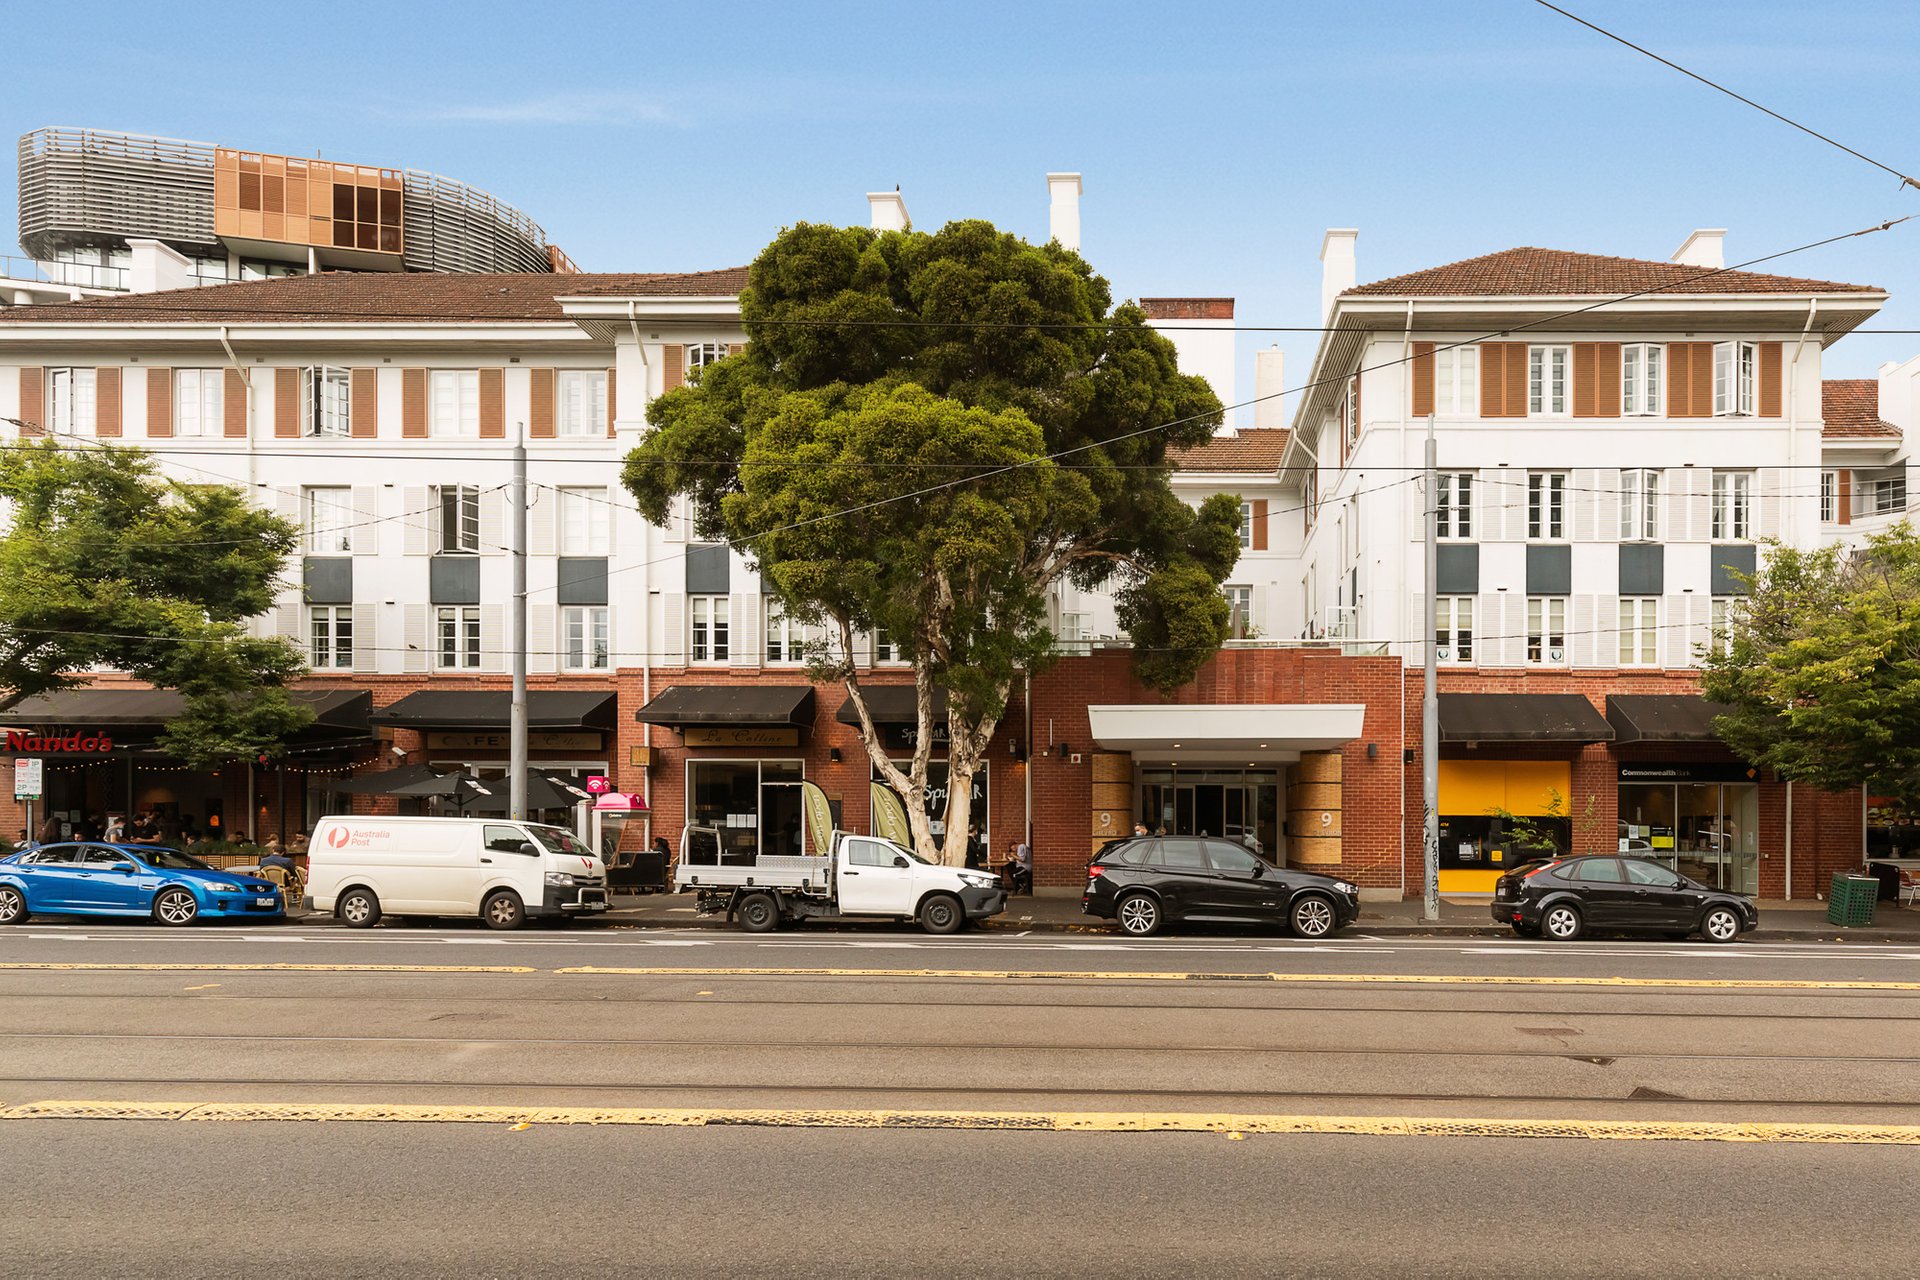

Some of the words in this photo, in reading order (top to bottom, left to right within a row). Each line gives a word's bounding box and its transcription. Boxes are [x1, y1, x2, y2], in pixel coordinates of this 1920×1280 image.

[2, 730, 113, 752] Nando's
[1100, 812, 1111, 827] 9
[1321, 812, 1332, 827] 9
[352, 830, 391, 838] Australia
[351, 838, 370, 846] Post
